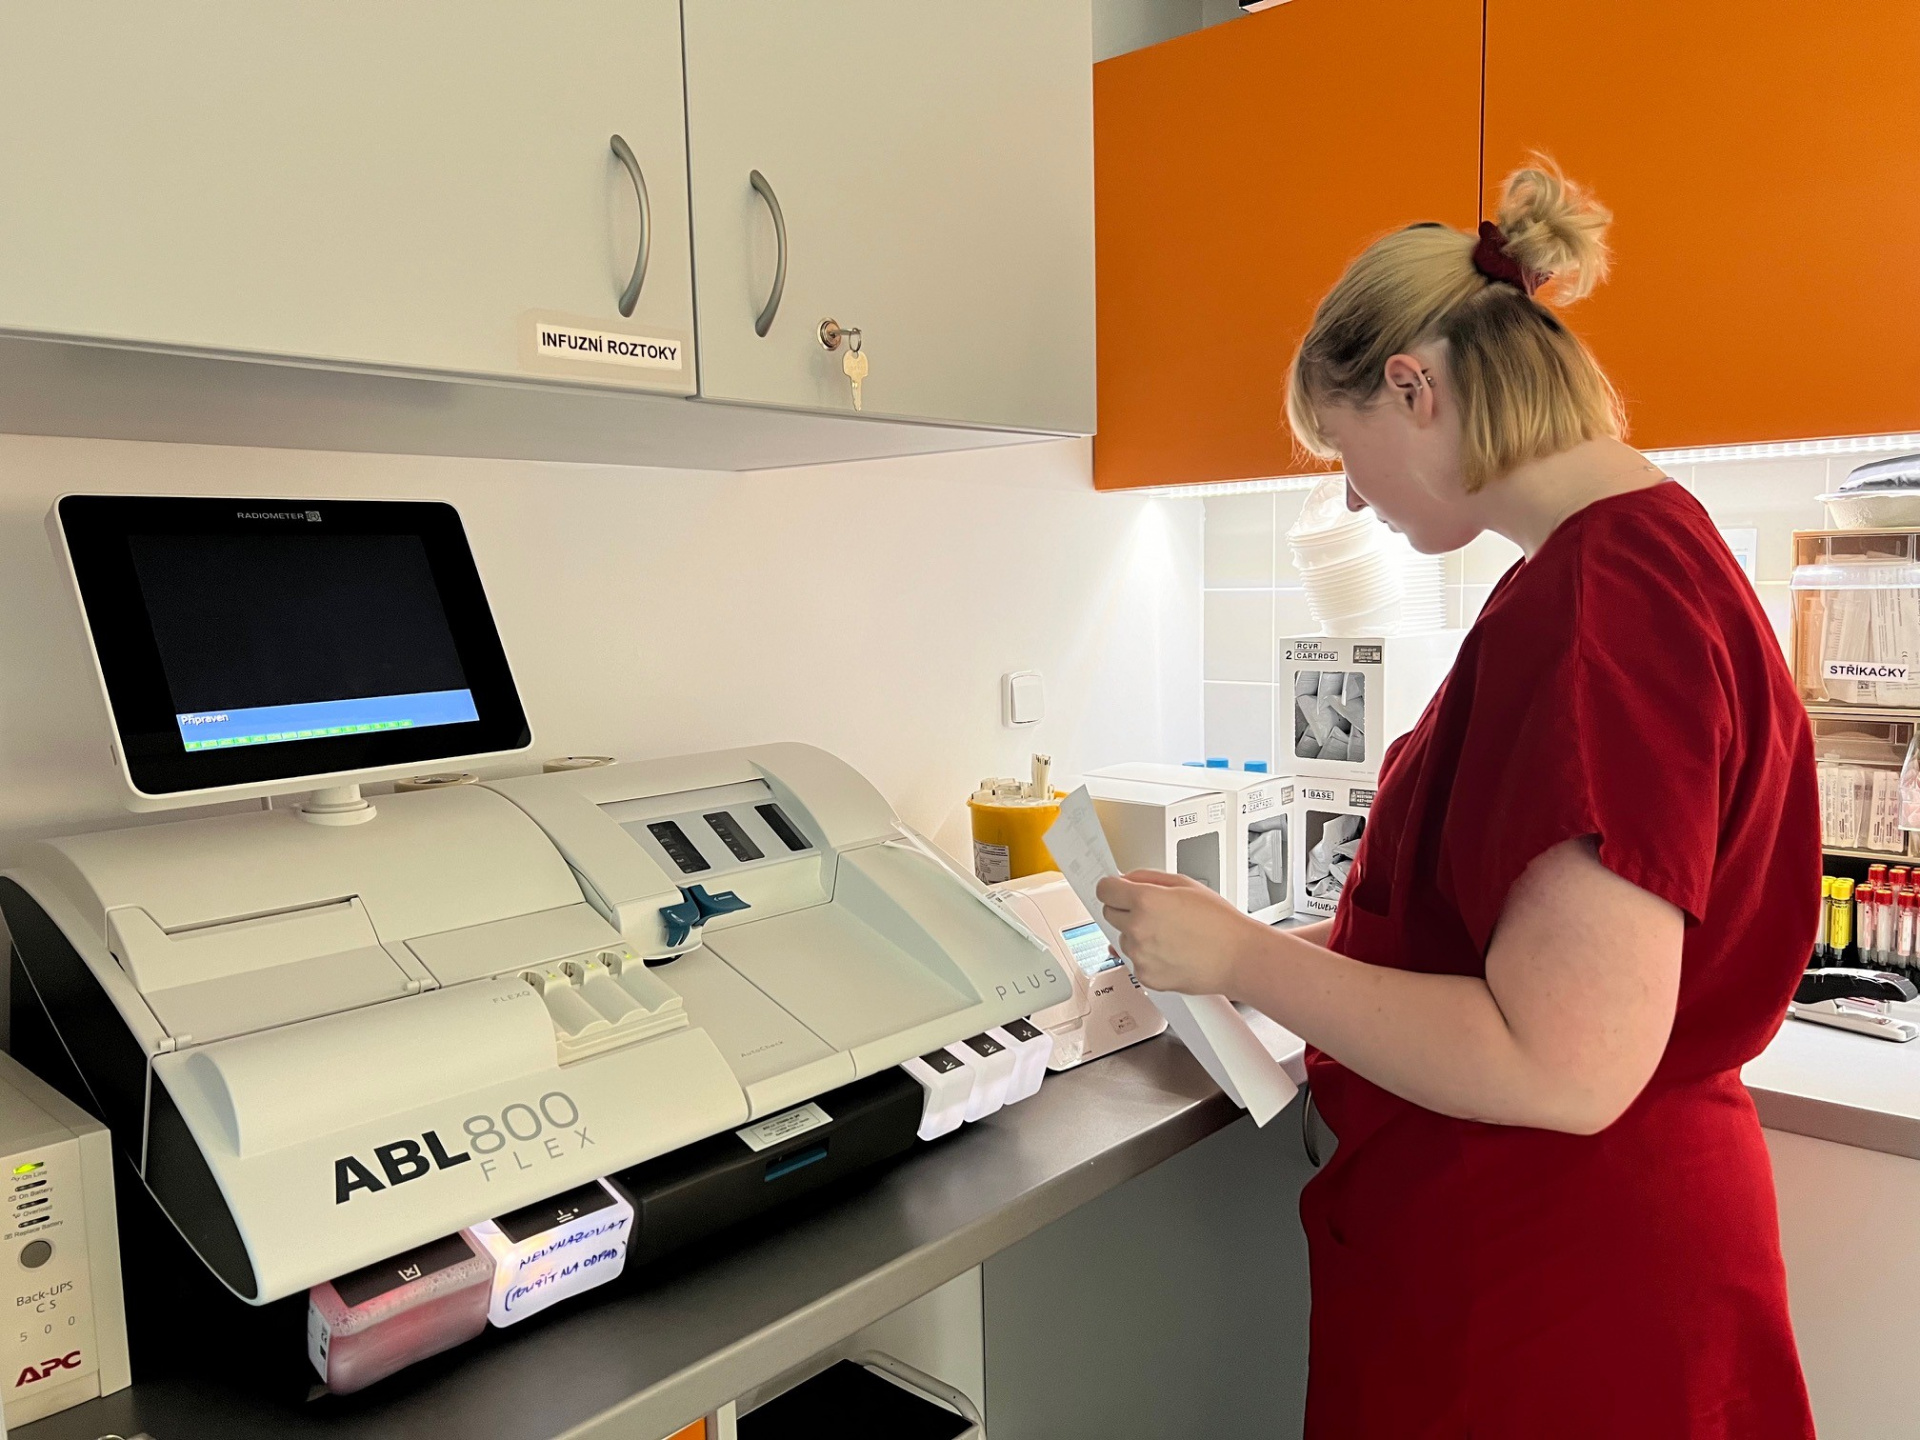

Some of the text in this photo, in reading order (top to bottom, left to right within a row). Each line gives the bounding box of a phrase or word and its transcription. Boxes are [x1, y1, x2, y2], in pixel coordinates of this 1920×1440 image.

[542, 332, 677, 360] INFUZNÍ ROZTOKY
[1285, 650, 1335, 660] 2 CARTRDG
[1829, 664, 1906, 678] STŘÍKAČKY
[181, 714, 229, 726] Připraven
[1301, 788, 1307, 798] 1
[1310, 790, 1332, 799] BASE
[1242, 803, 1247, 814] 2
[1172, 814, 1197, 827] 1 BASE
[995, 969, 1057, 1000] PLUS
[480, 1126, 596, 1182] FLEX
[16, 1281, 73, 1307] Back-UPS
[15, 1350, 82, 1388] APC
